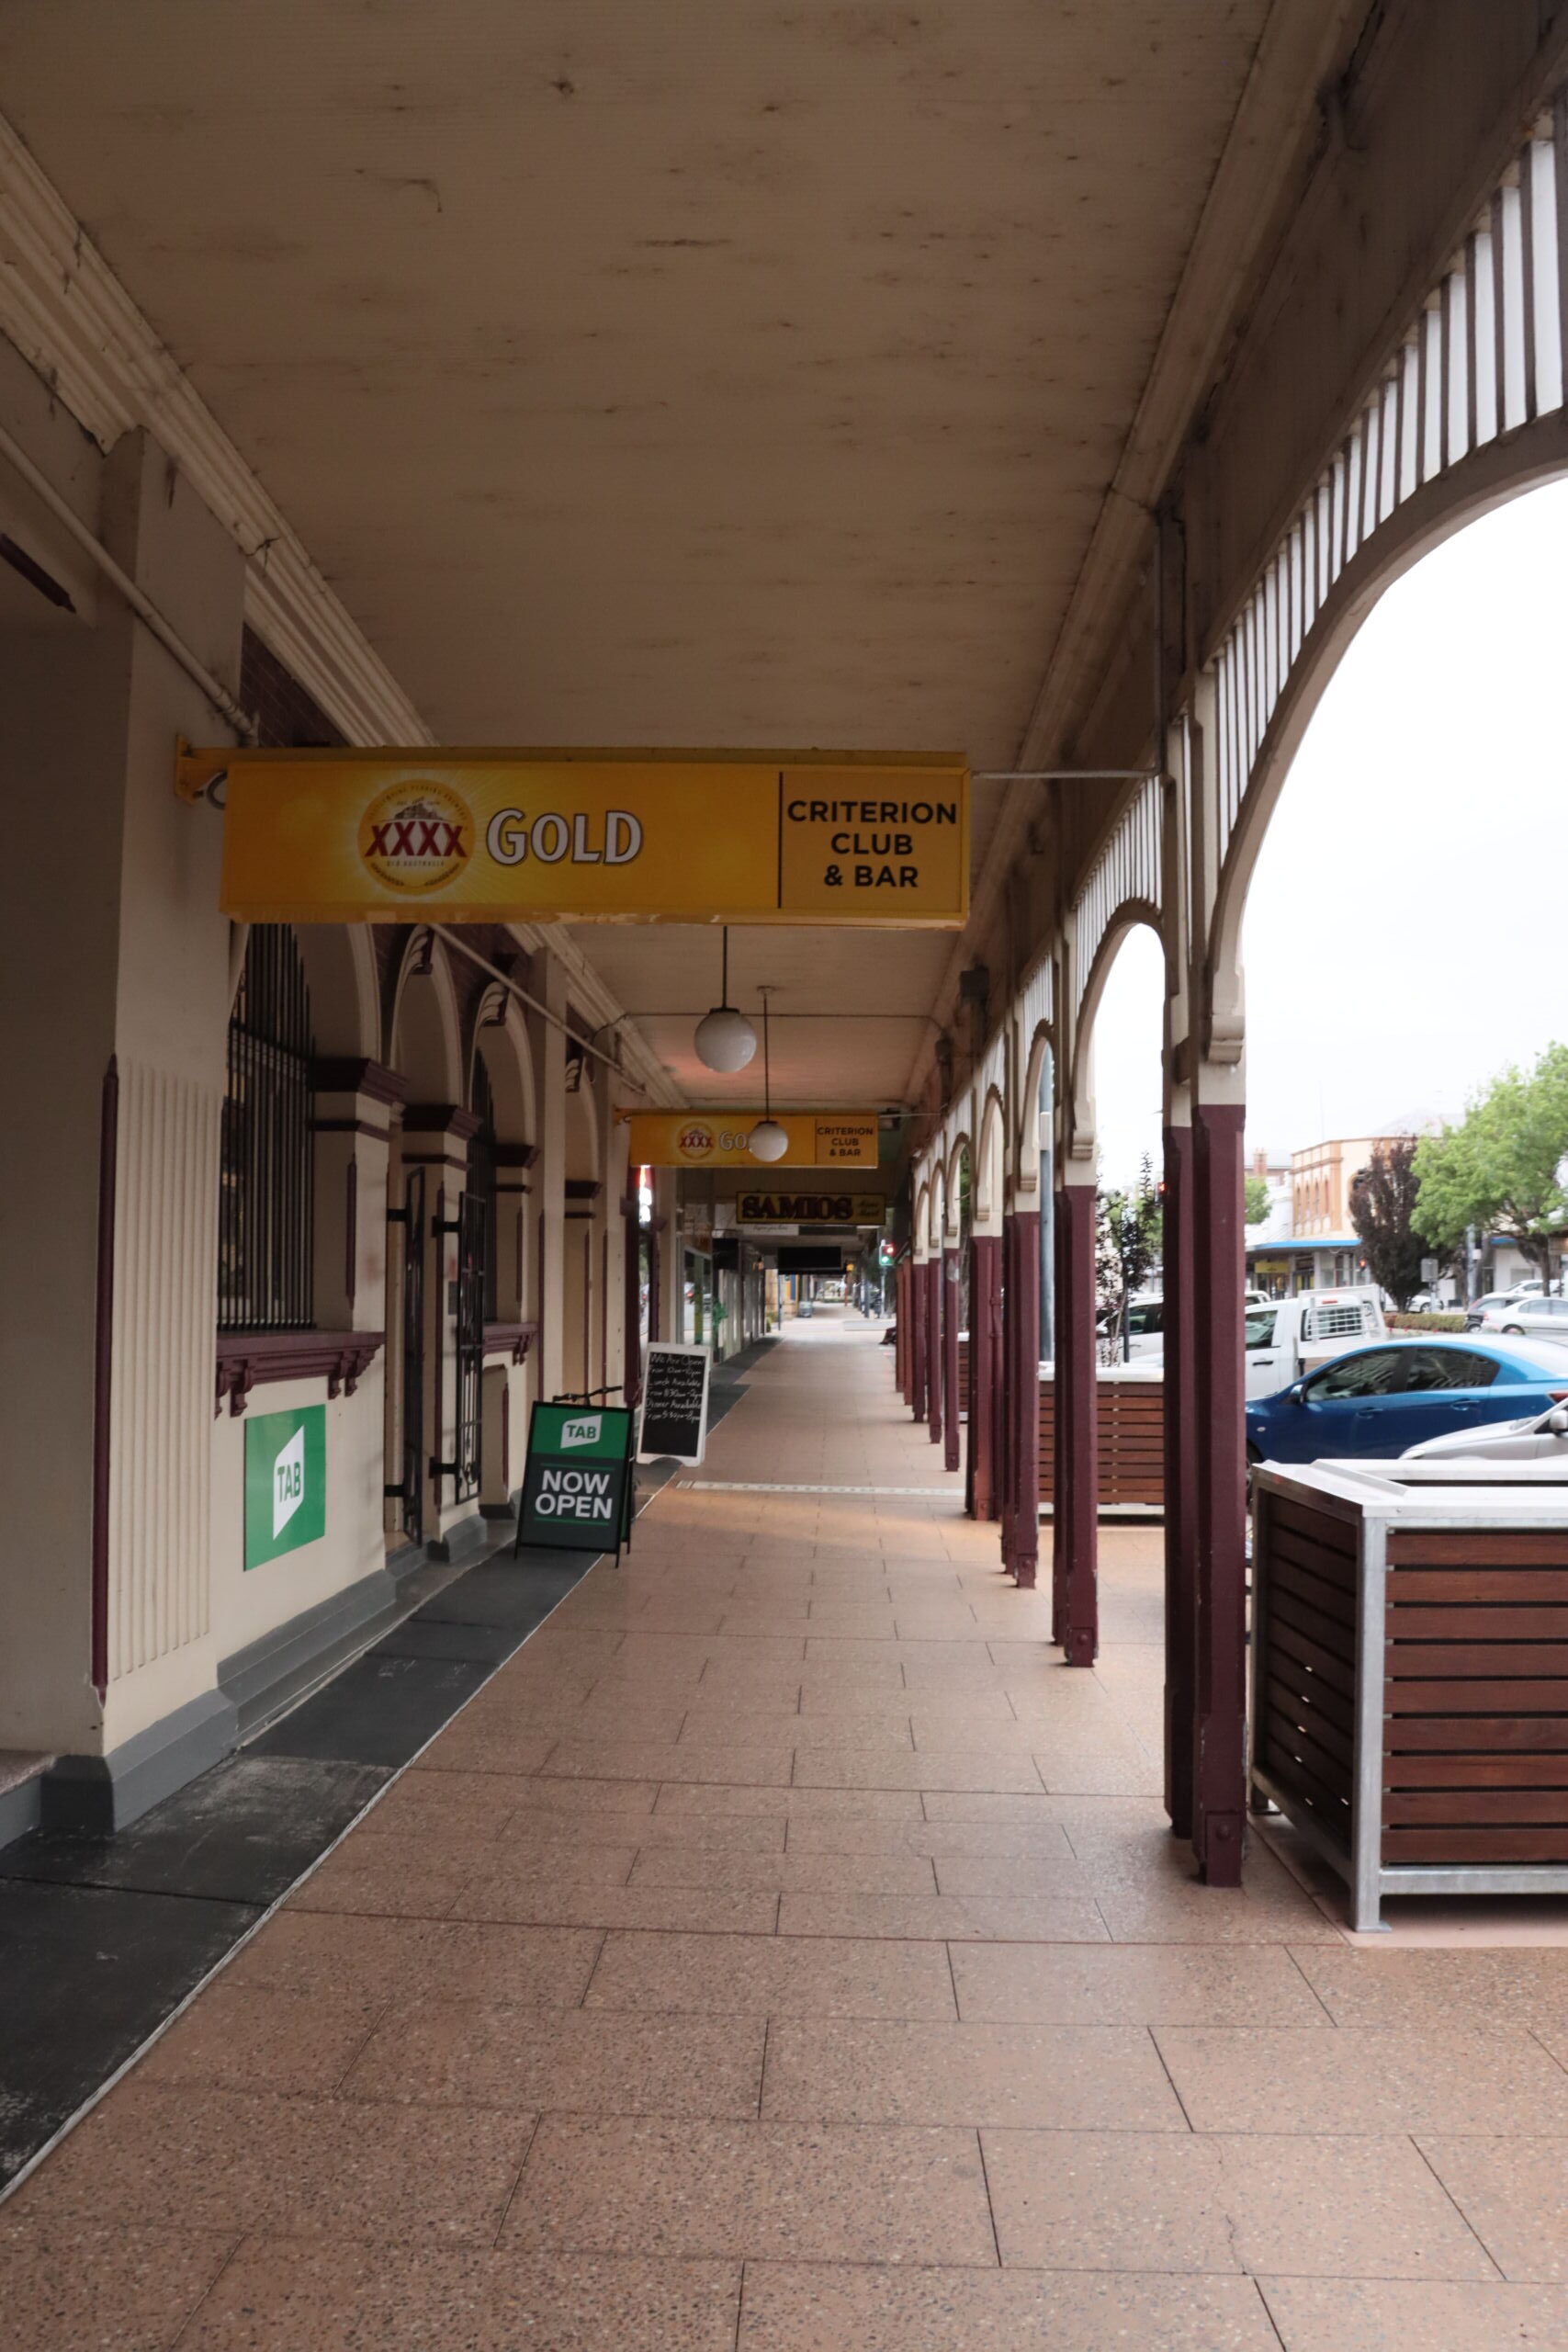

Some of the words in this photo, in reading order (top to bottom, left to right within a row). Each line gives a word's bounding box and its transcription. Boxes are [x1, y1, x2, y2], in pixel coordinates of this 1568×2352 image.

[787, 800, 956, 824] CRITERION
[365, 820, 468, 858] XXXX
[485, 808, 644, 865] GOLD
[830, 832, 913, 855] CLUB
[824, 864, 842, 887] &
[854, 865, 919, 888] BAR
[680, 1136, 713, 1148] XXXX
[719, 1131, 749, 1150] GO
[817, 1127, 873, 1136] CRITERION
[831, 1137, 859, 1146] CLUB
[741, 1196, 854, 1220] SAMIOS
[567, 1424, 597, 1440] TAB
[277, 1461, 301, 1503] TAB
[542, 1470, 610, 1495] NOW
[536, 1493, 613, 1519] OPEN
